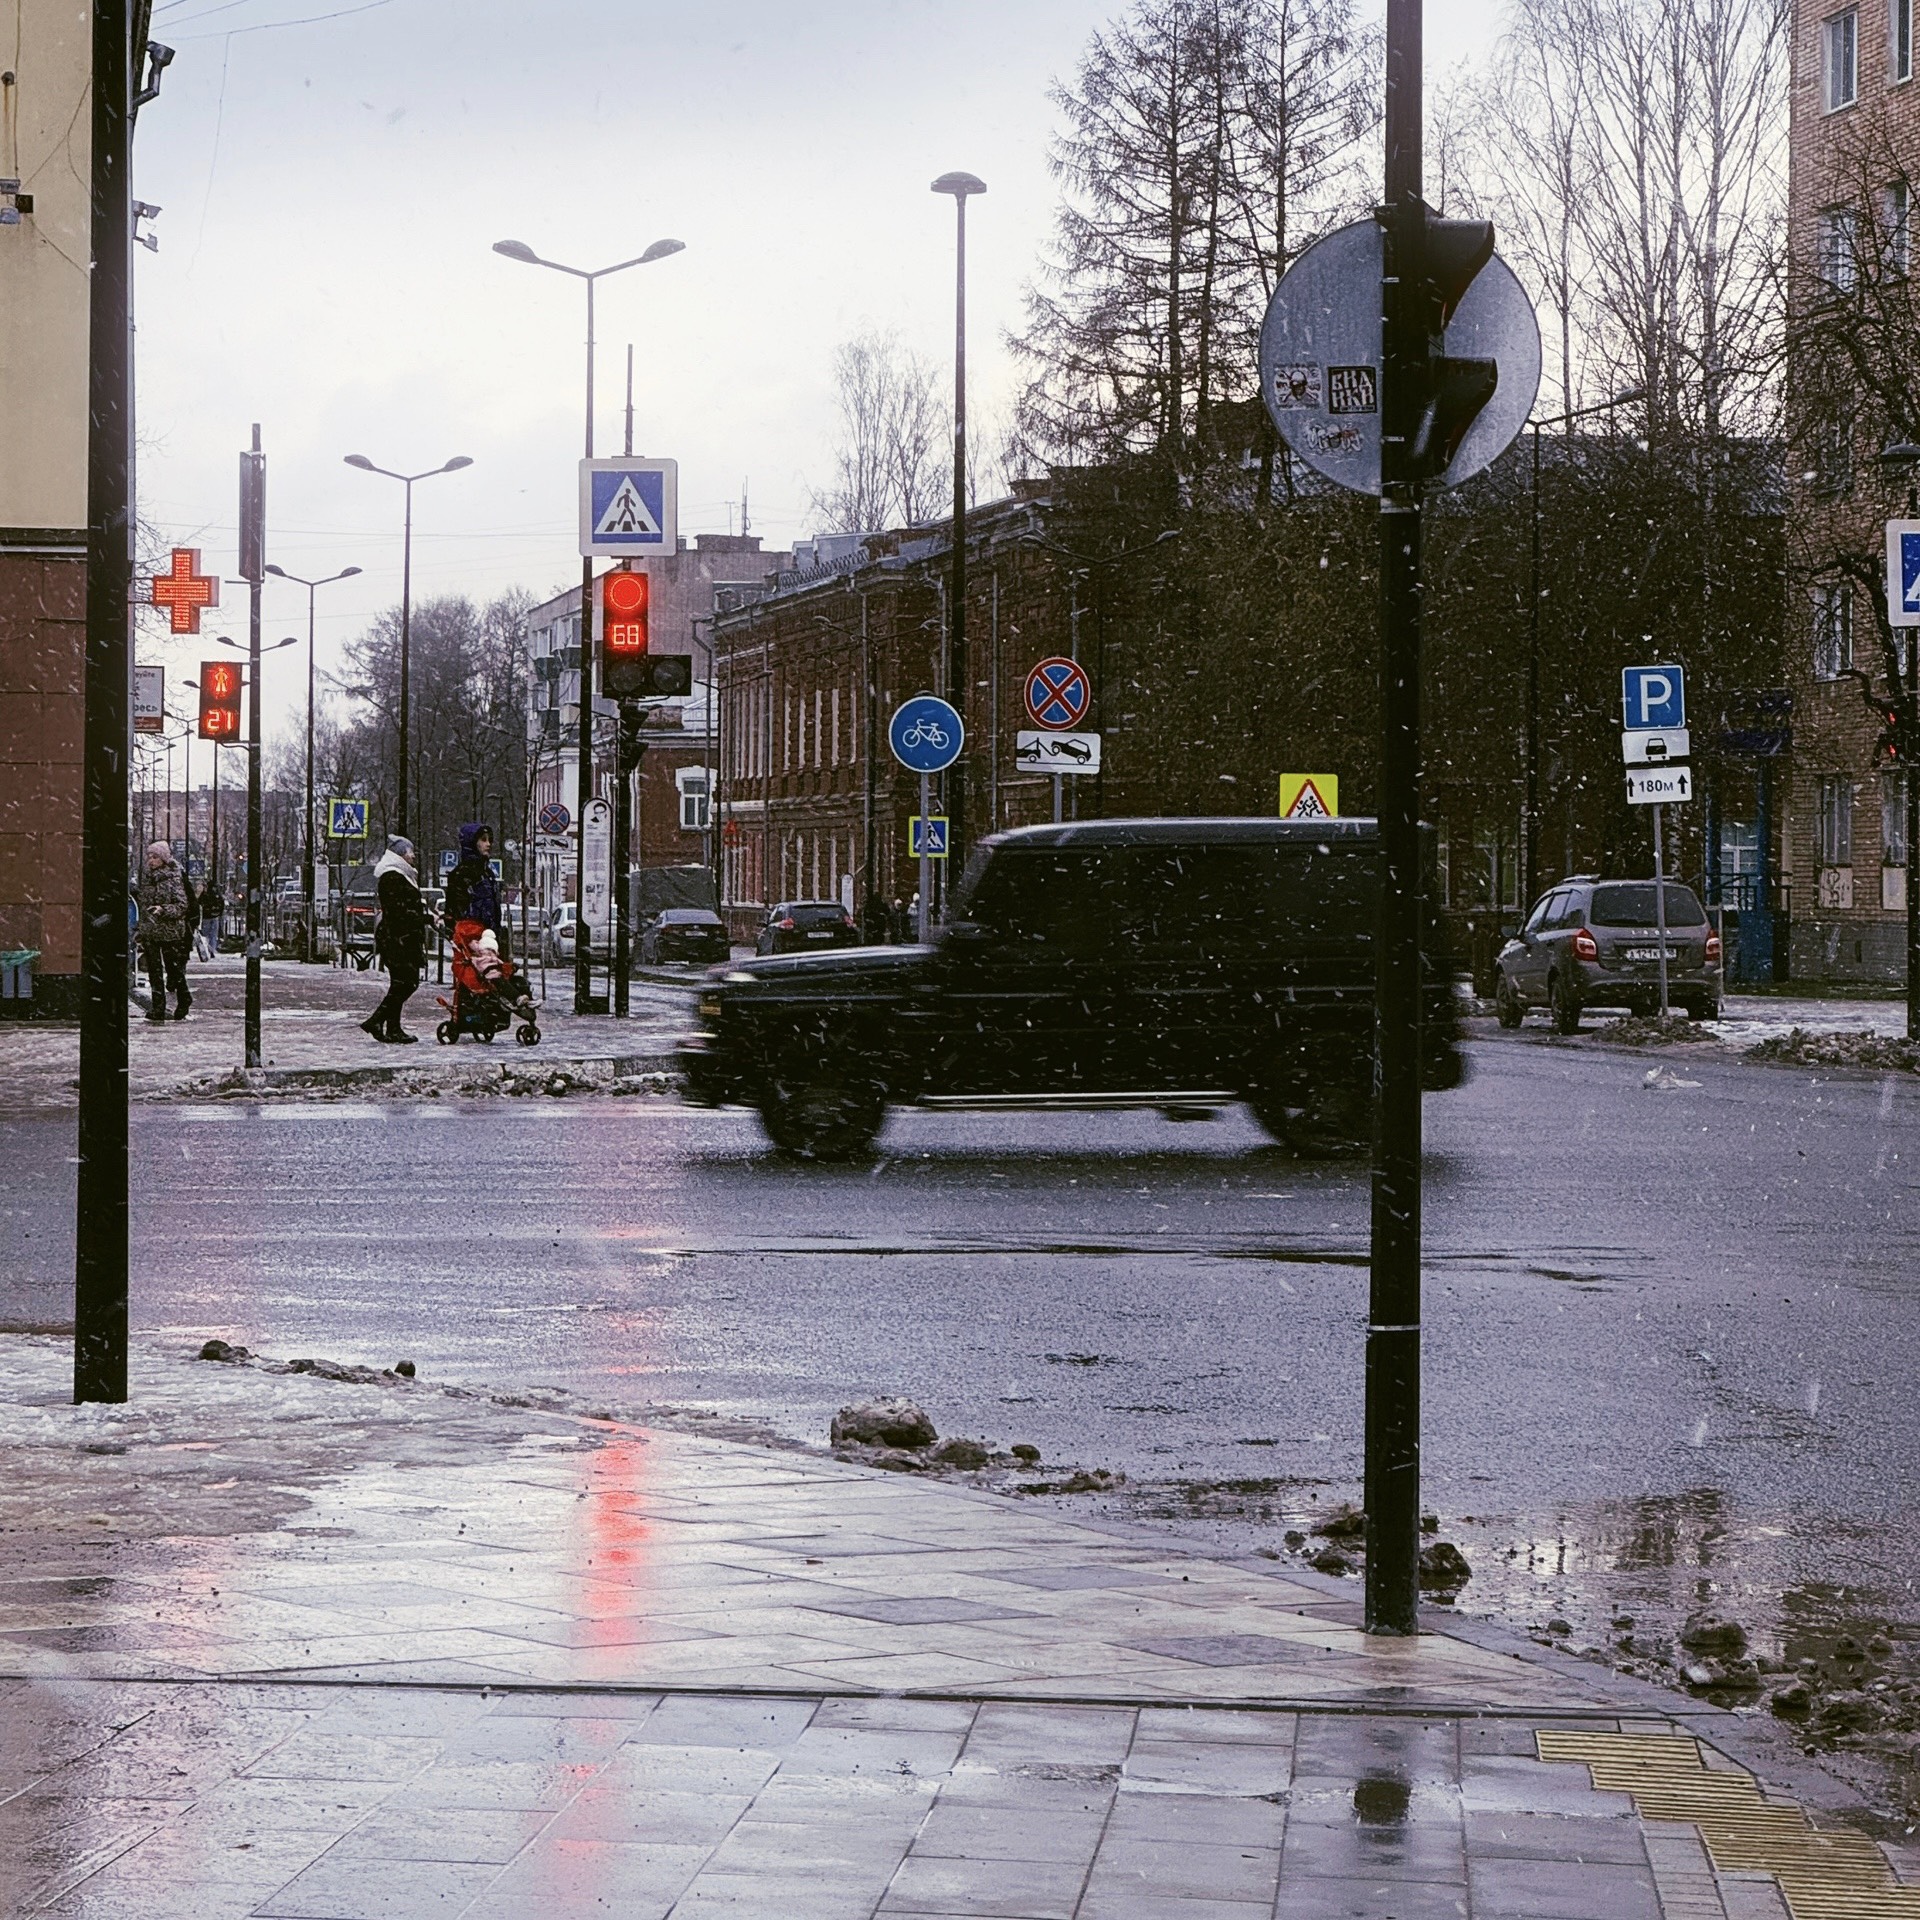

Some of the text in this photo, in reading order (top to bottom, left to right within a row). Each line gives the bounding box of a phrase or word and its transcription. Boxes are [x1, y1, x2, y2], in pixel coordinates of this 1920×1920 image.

[614, 624, 639, 645] 68
[1639, 674, 1672, 722] P
[207, 708, 233, 730] 21
